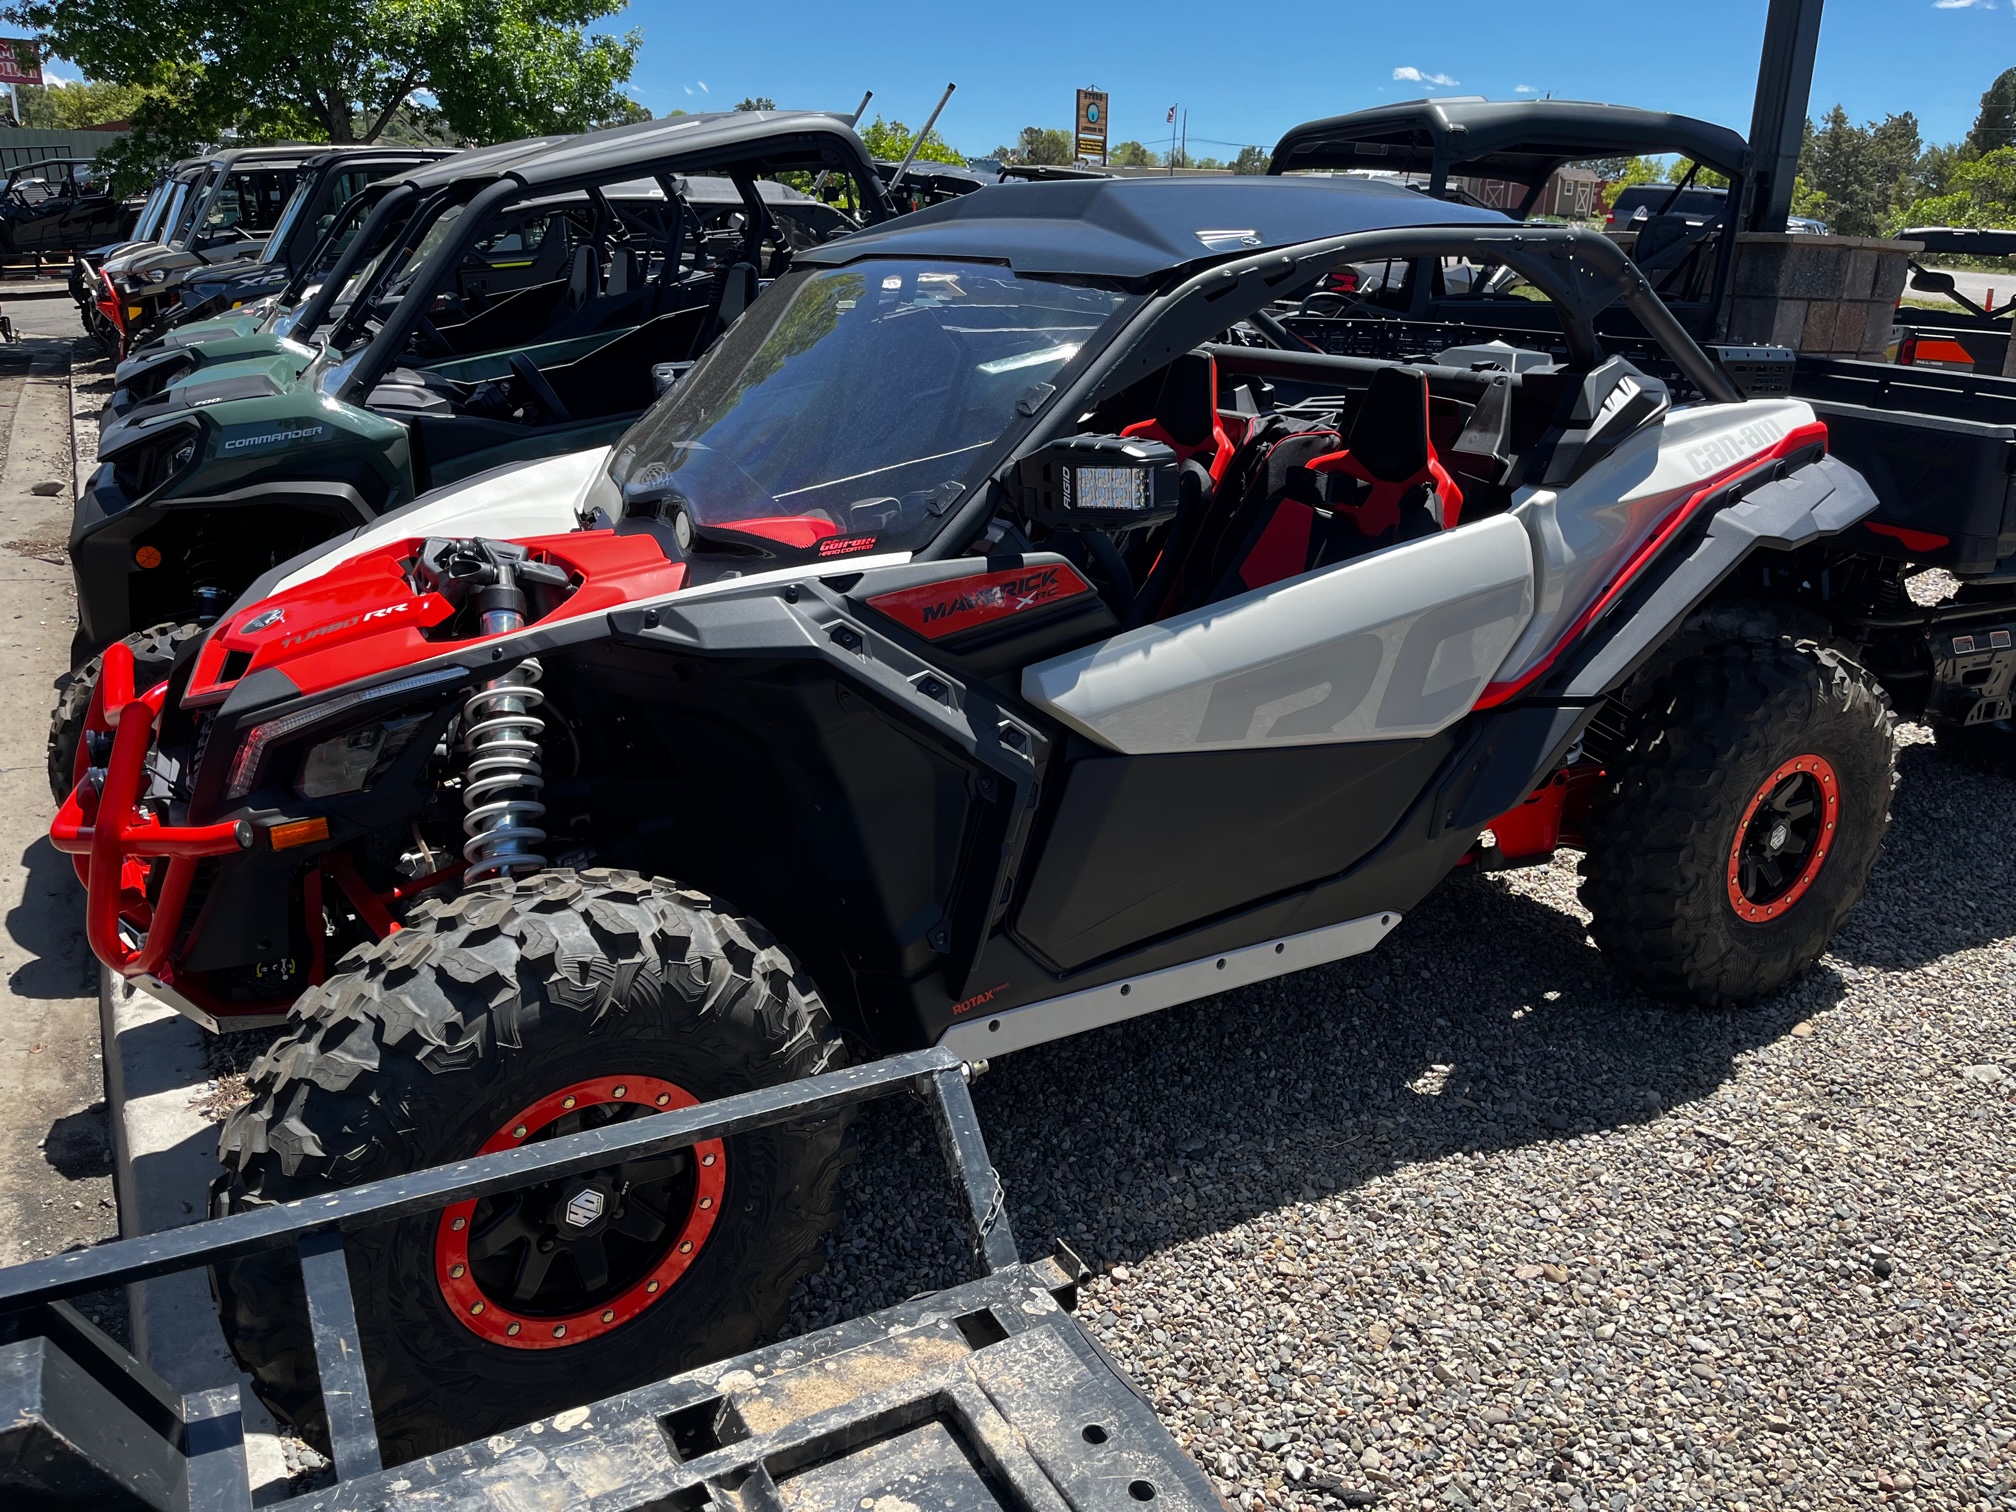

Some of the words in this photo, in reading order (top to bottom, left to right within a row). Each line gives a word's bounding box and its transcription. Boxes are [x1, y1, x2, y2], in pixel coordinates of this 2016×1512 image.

[236, 274, 285, 289] XP
[193, 397, 223, 406] 700
[224, 426, 323, 450] COMMANDER
[1684, 418, 1785, 476] can-am
[1062, 466, 1071, 510] RIGID
[818, 549, 841, 557] HARD
[841, 544, 874, 554] COATED
[922, 567, 1060, 624] MAVERICK
[281, 616, 361, 649] TURBO
[363, 602, 409, 622] RR
[952, 989, 994, 1016] ROTAX
